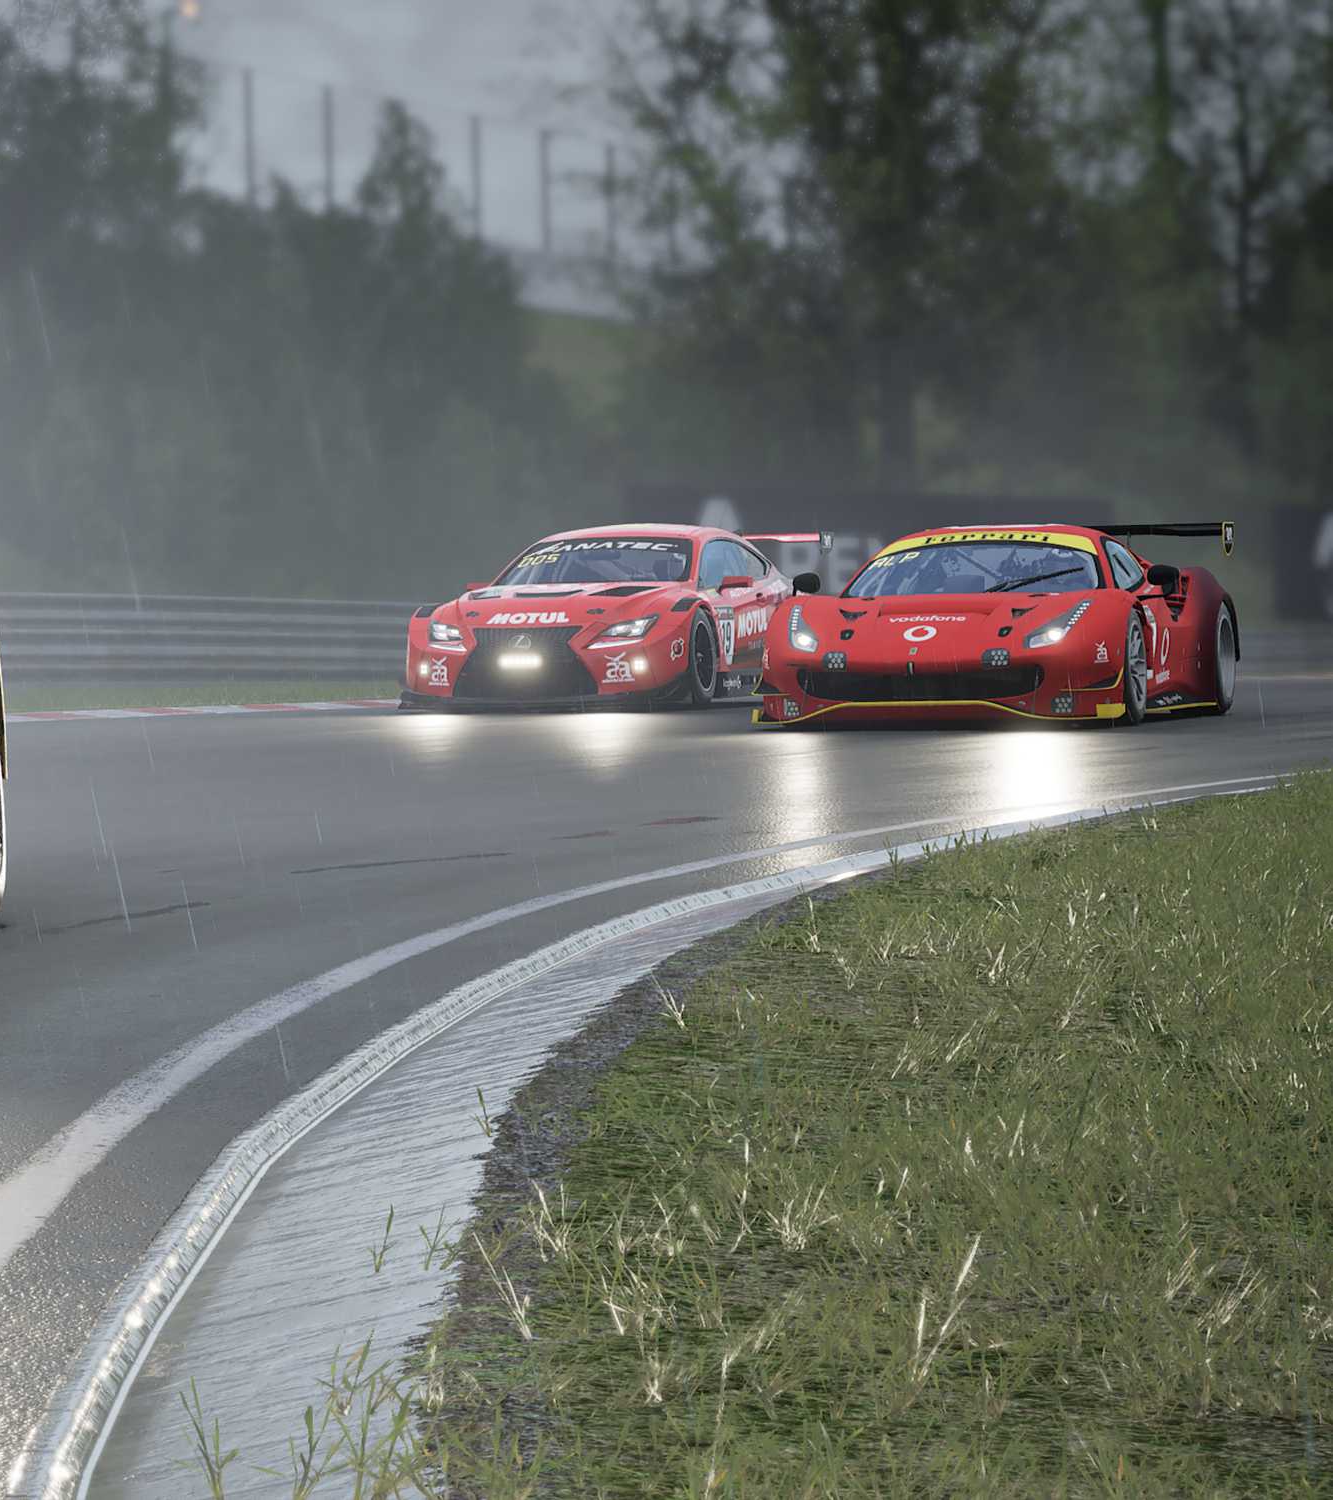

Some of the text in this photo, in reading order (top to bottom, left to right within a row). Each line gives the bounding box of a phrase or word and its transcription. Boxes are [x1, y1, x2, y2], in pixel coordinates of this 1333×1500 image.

[924, 532, 1051, 544] Ferrari
[485, 611, 570, 625] MOTUL
[889, 614, 966, 623] vodafone
